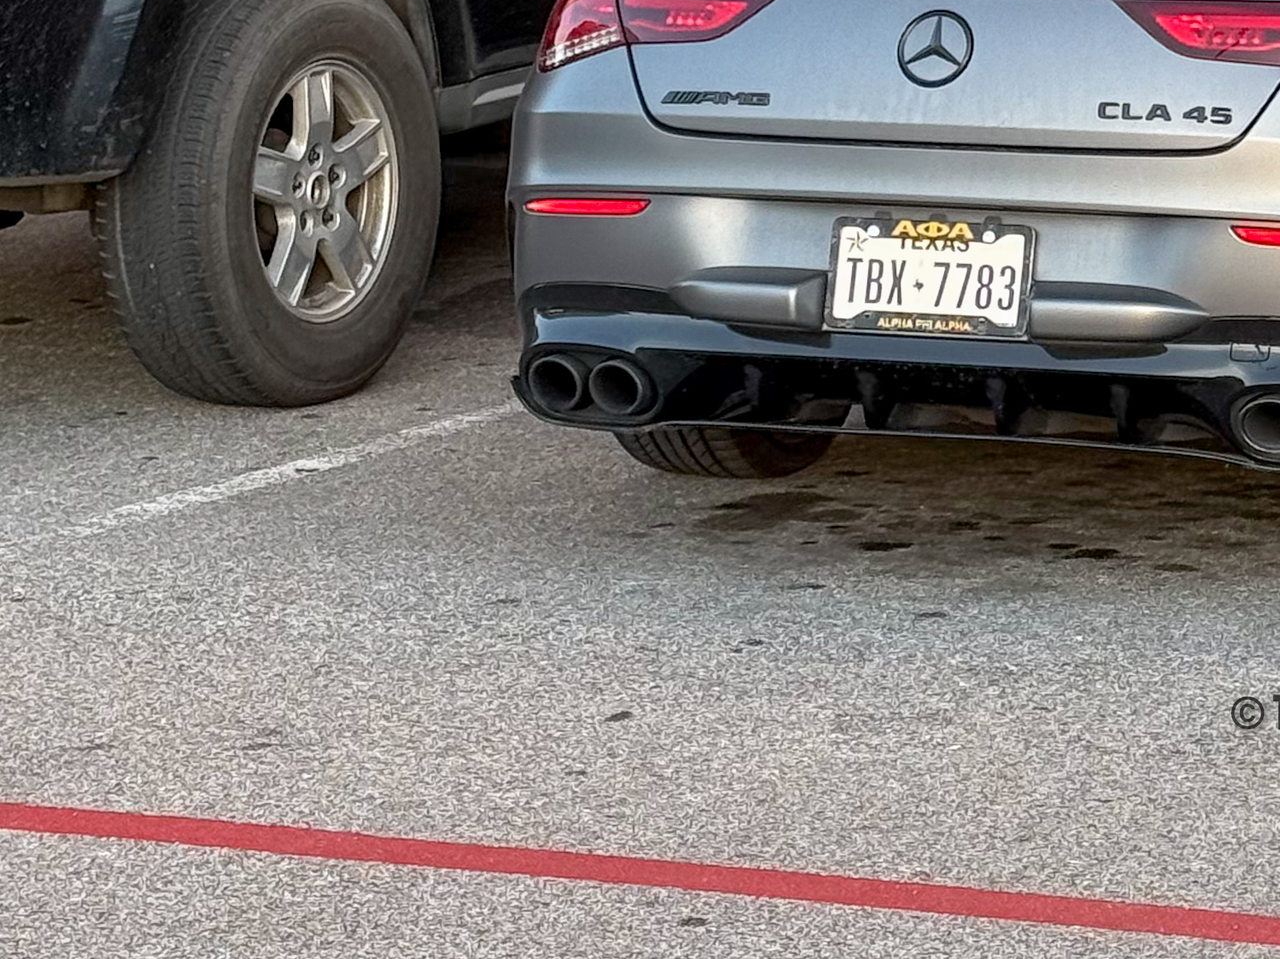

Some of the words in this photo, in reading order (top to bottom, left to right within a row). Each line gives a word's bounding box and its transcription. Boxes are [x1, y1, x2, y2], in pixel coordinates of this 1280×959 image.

[693, 91, 770, 106] AMG
[1098, 101, 1172, 121] CLA
[1182, 105, 1233, 125] 45
[846, 257, 906, 305] TBX
[933, 261, 1016, 311] 7783
[877, 317, 913, 328] ALPHA
[934, 321, 971, 332] ALPHA
